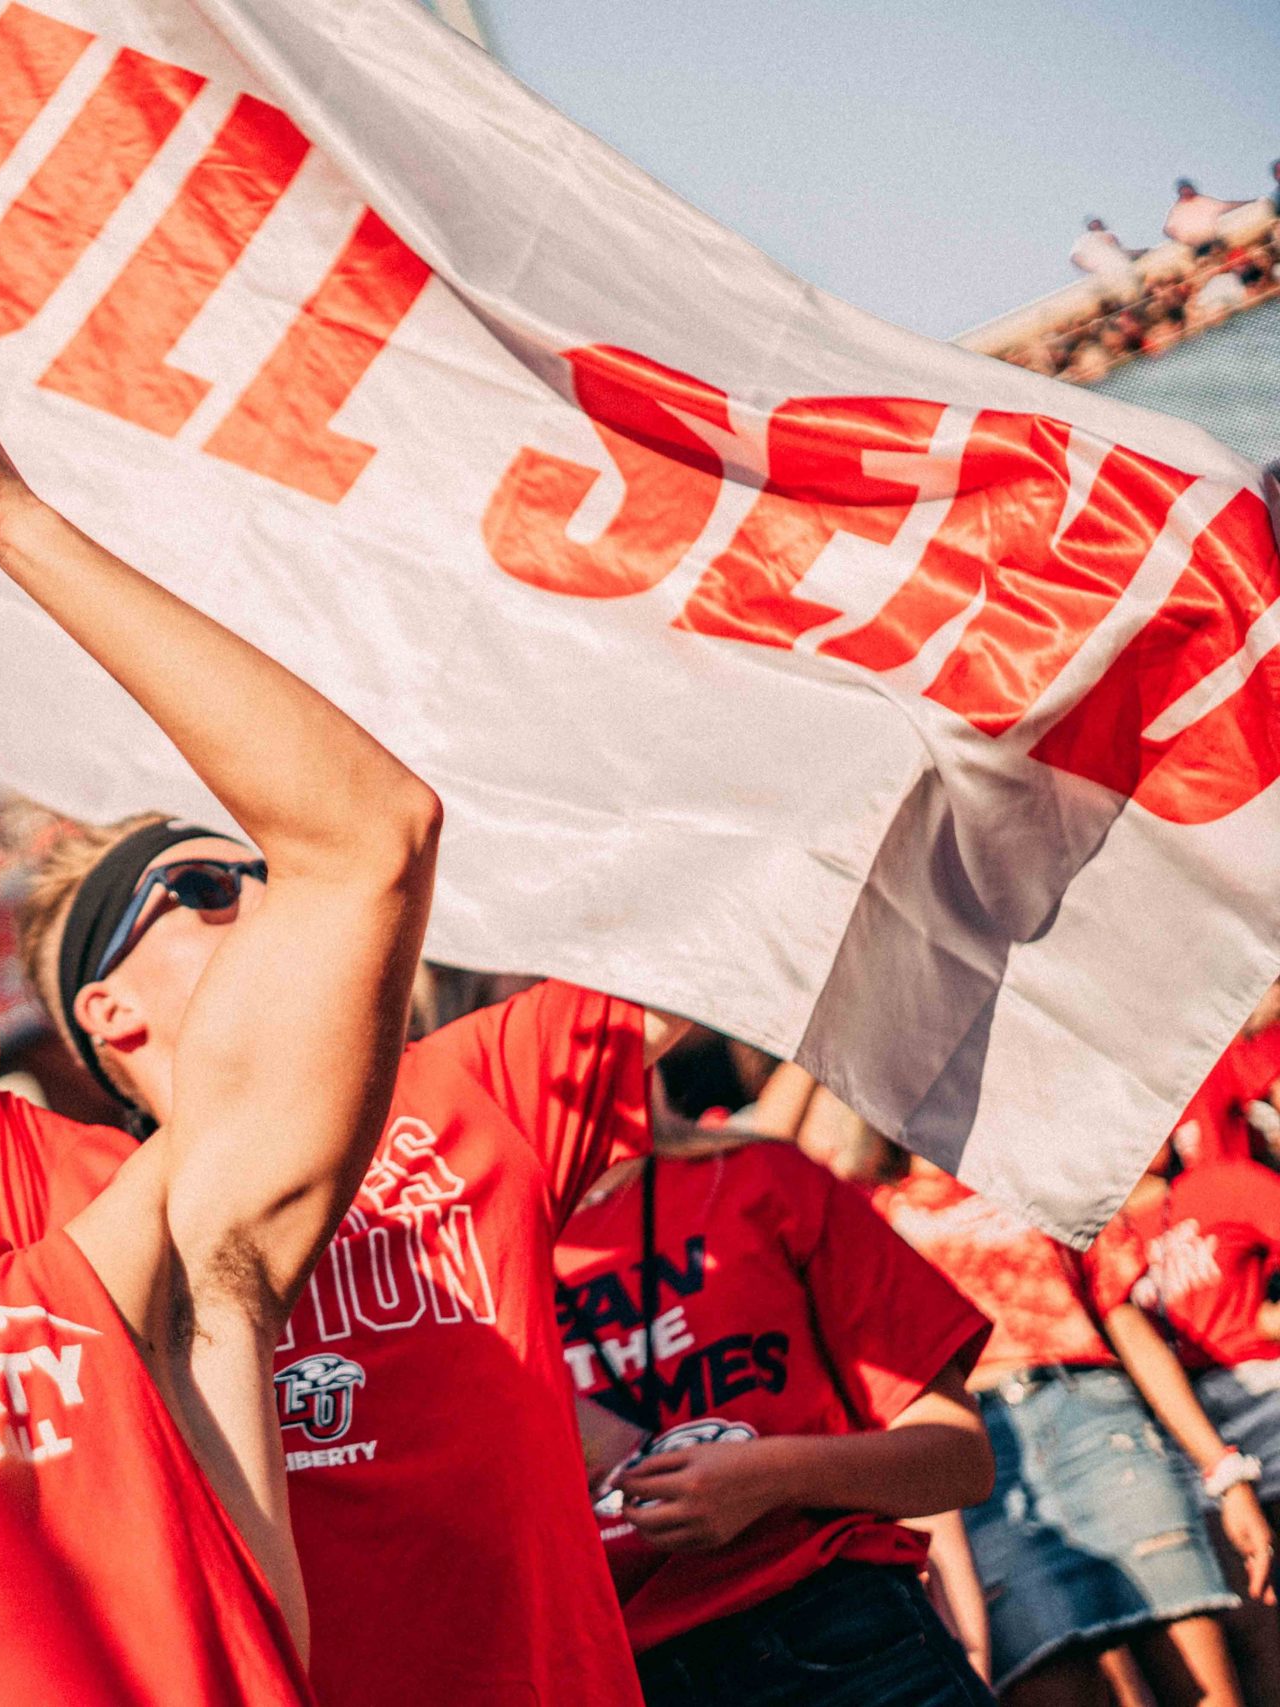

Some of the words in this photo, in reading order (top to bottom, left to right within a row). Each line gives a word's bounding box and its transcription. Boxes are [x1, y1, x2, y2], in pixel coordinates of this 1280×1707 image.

[481, 343, 1280, 826] SEND
[562, 1305, 696, 1391] THE
[284, 1440, 378, 1472] IBERTY
